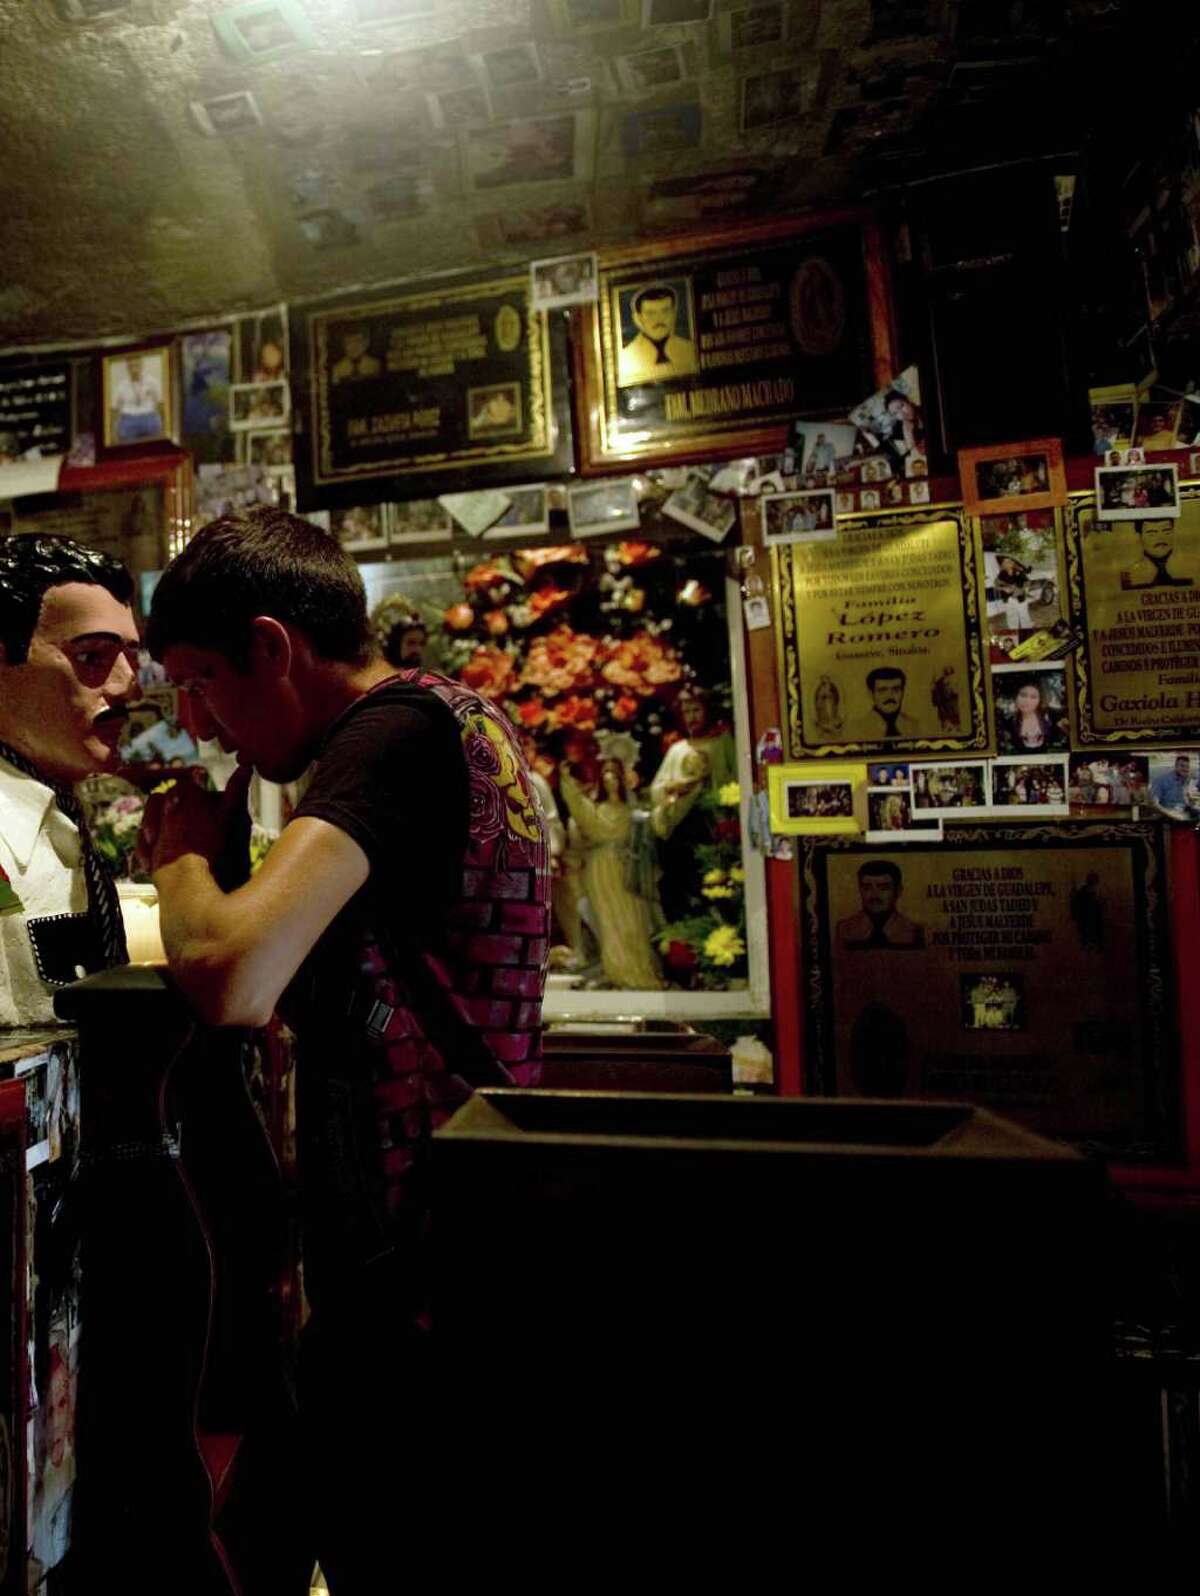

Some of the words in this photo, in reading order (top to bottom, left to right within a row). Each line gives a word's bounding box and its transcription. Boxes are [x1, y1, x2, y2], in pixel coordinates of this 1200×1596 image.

[844, 596, 915, 610] Familia
[840, 611, 925, 627] López
[827, 629, 941, 646] Romero
[1100, 691, 1179, 712] Gaxiola
